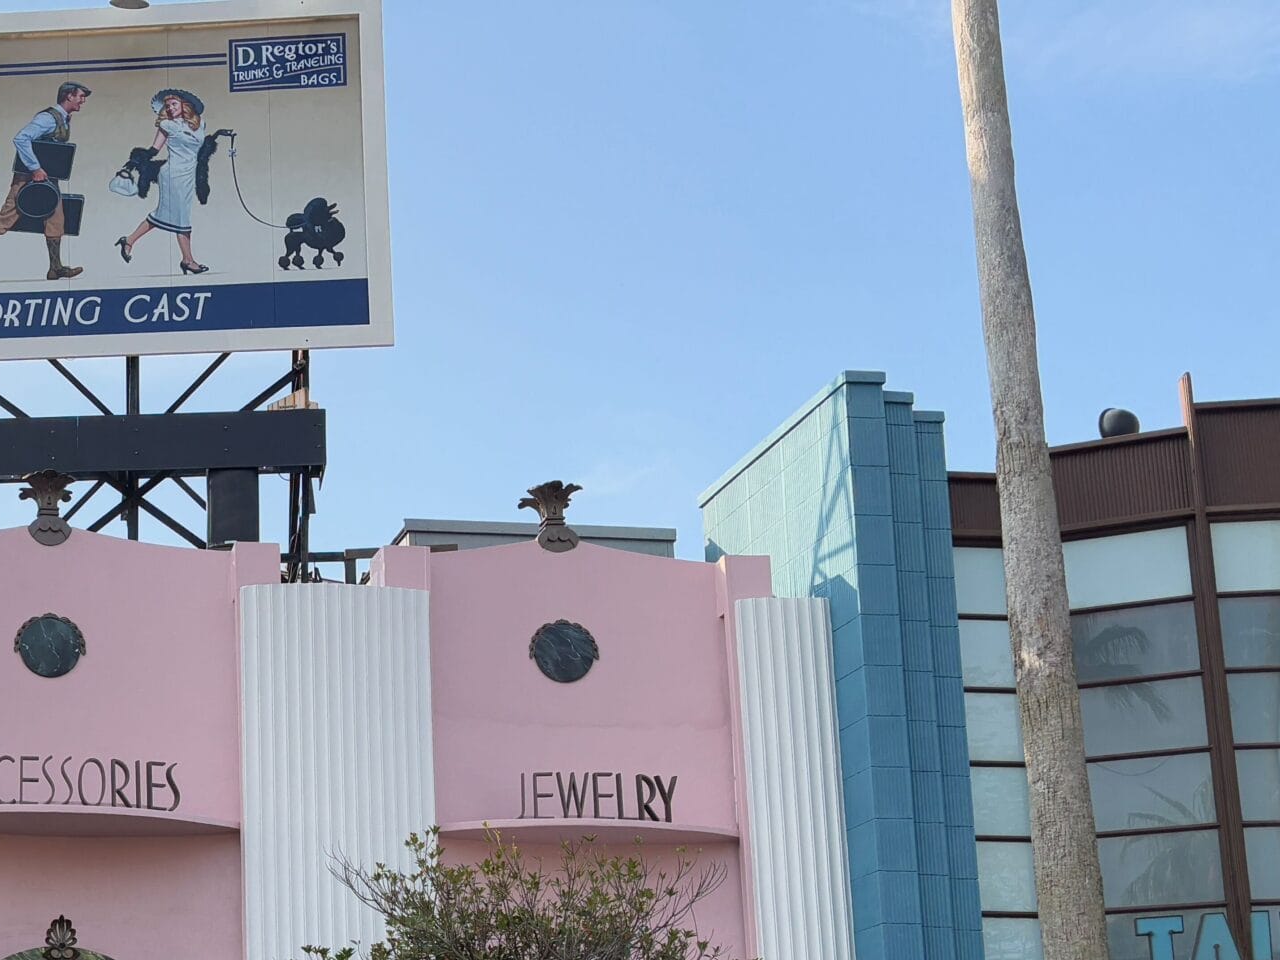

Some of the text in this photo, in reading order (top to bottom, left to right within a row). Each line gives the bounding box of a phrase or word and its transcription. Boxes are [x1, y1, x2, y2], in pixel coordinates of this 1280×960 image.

[233, 53, 343, 82] TRUNKS & TRAVELING
[237, 40, 338, 67] D. Regtor's
[300, 72, 337, 86] BAGS
[123, 292, 212, 324] CAST
[516, 771, 678, 823] JEWELRY
